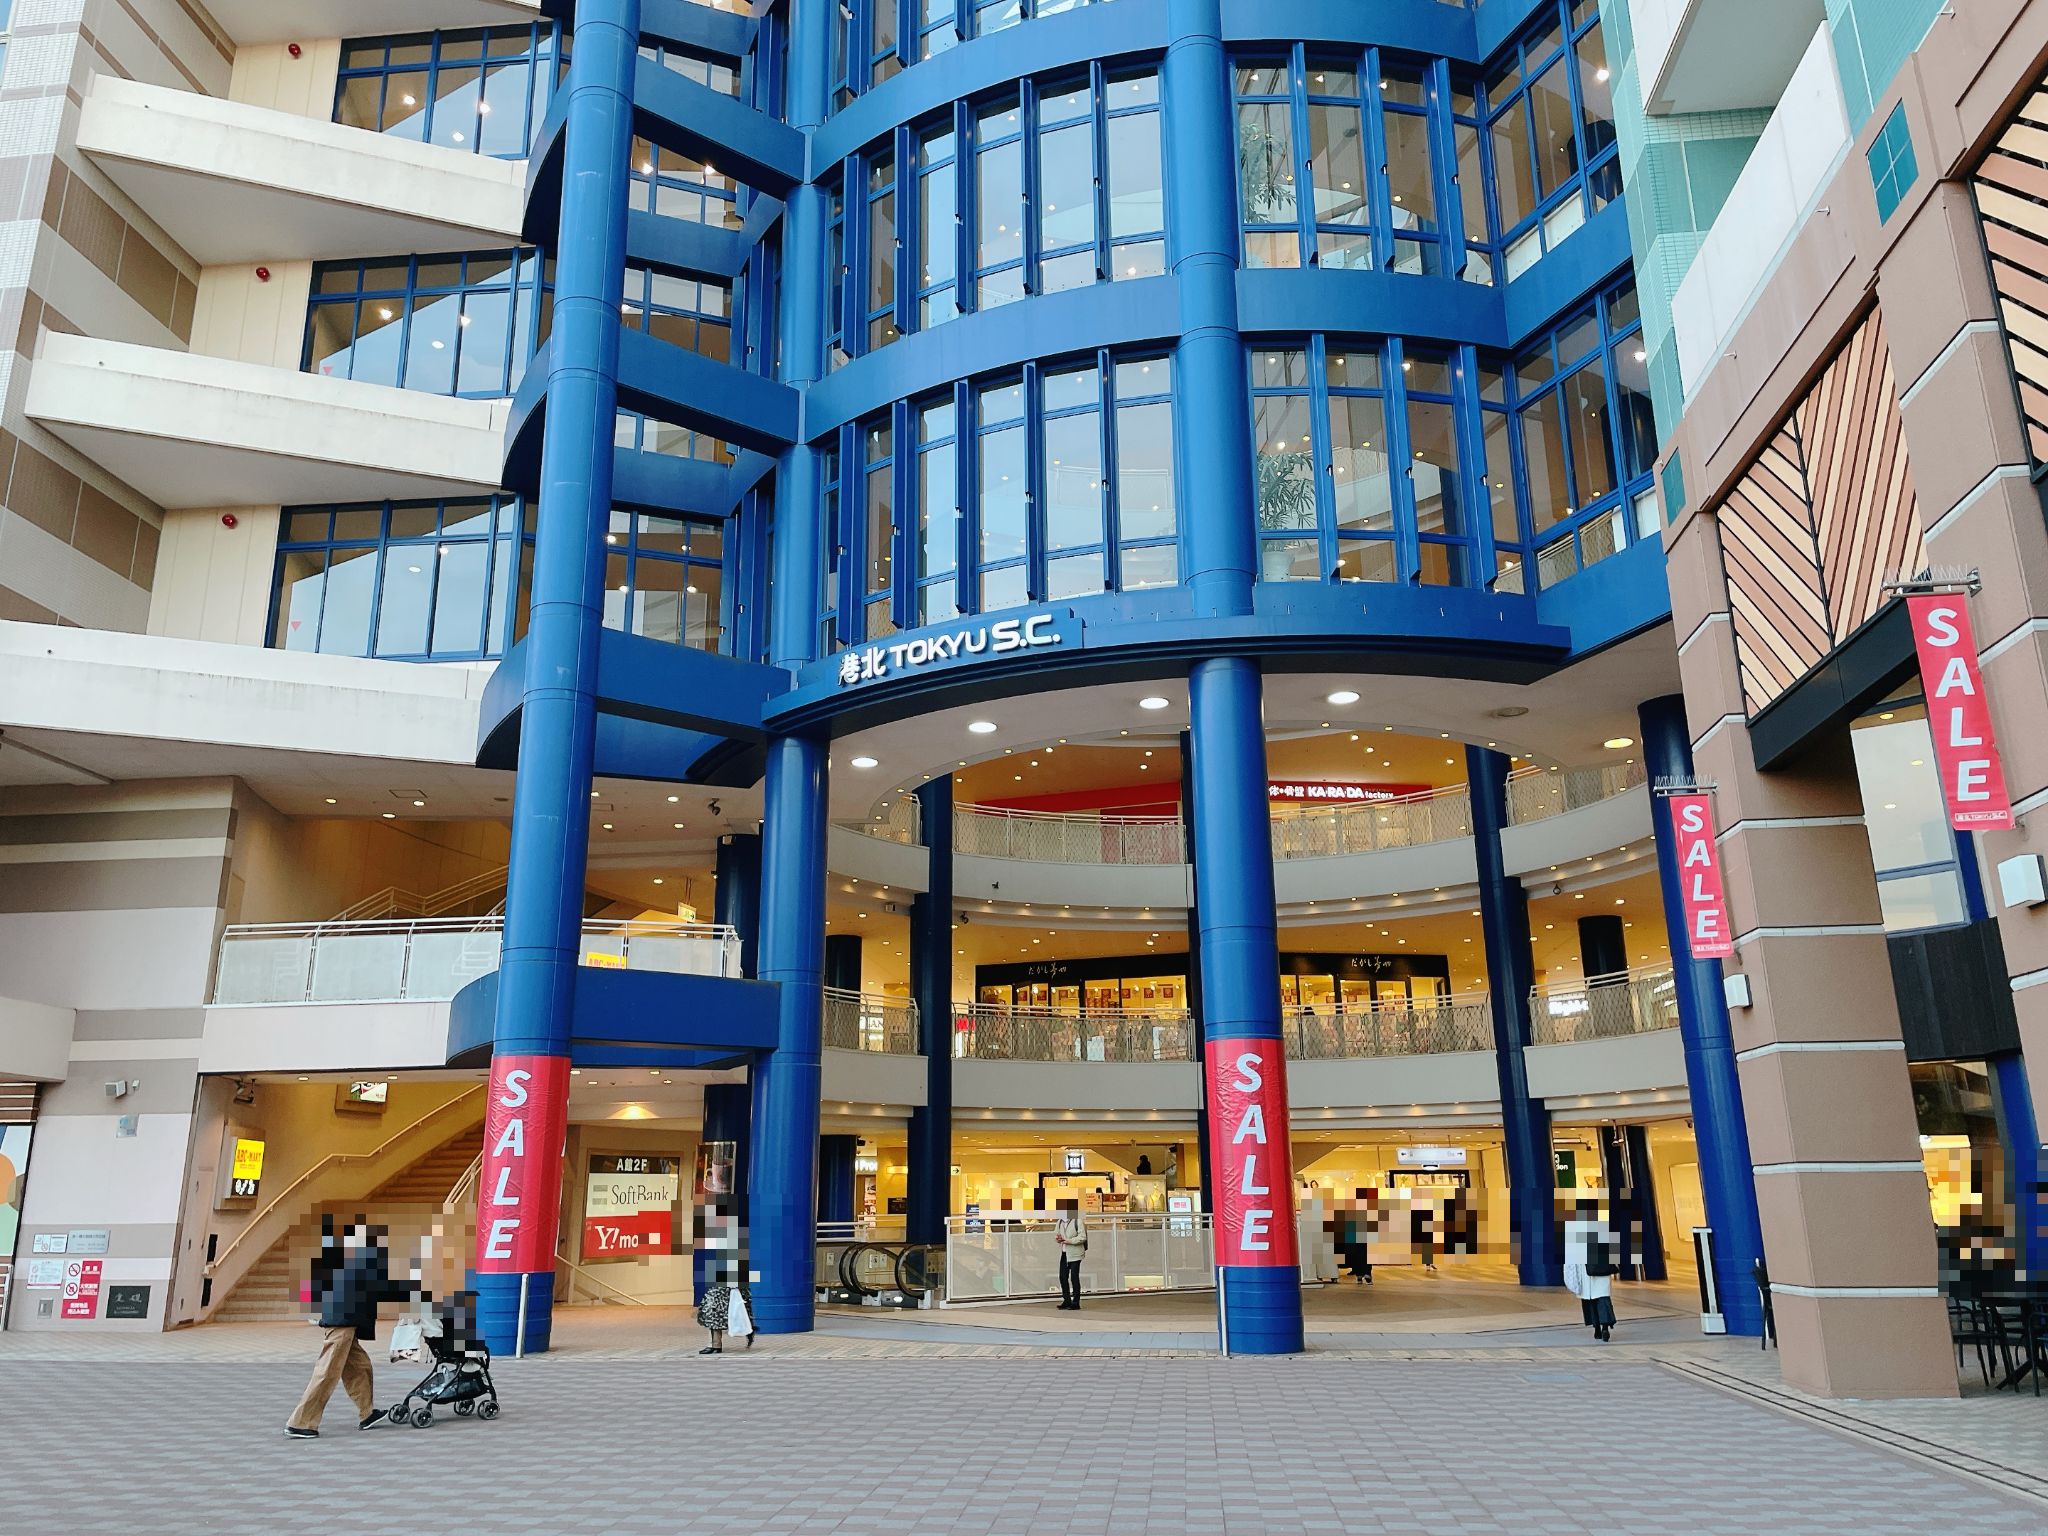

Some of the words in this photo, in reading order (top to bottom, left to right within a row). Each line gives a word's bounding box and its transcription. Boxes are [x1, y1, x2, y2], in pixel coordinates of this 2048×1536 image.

[838, 648, 887, 684] 港北
[890, 627, 988, 668] TOKYU
[991, 614, 1062, 651] S.C.
[1926, 608, 1991, 802] SALE
[1681, 804, 1720, 938] SALE
[485, 1070, 532, 1259] SALE
[611, 1184, 669, 1205] SoftBank
[1232, 1053, 1274, 1251] SALE
